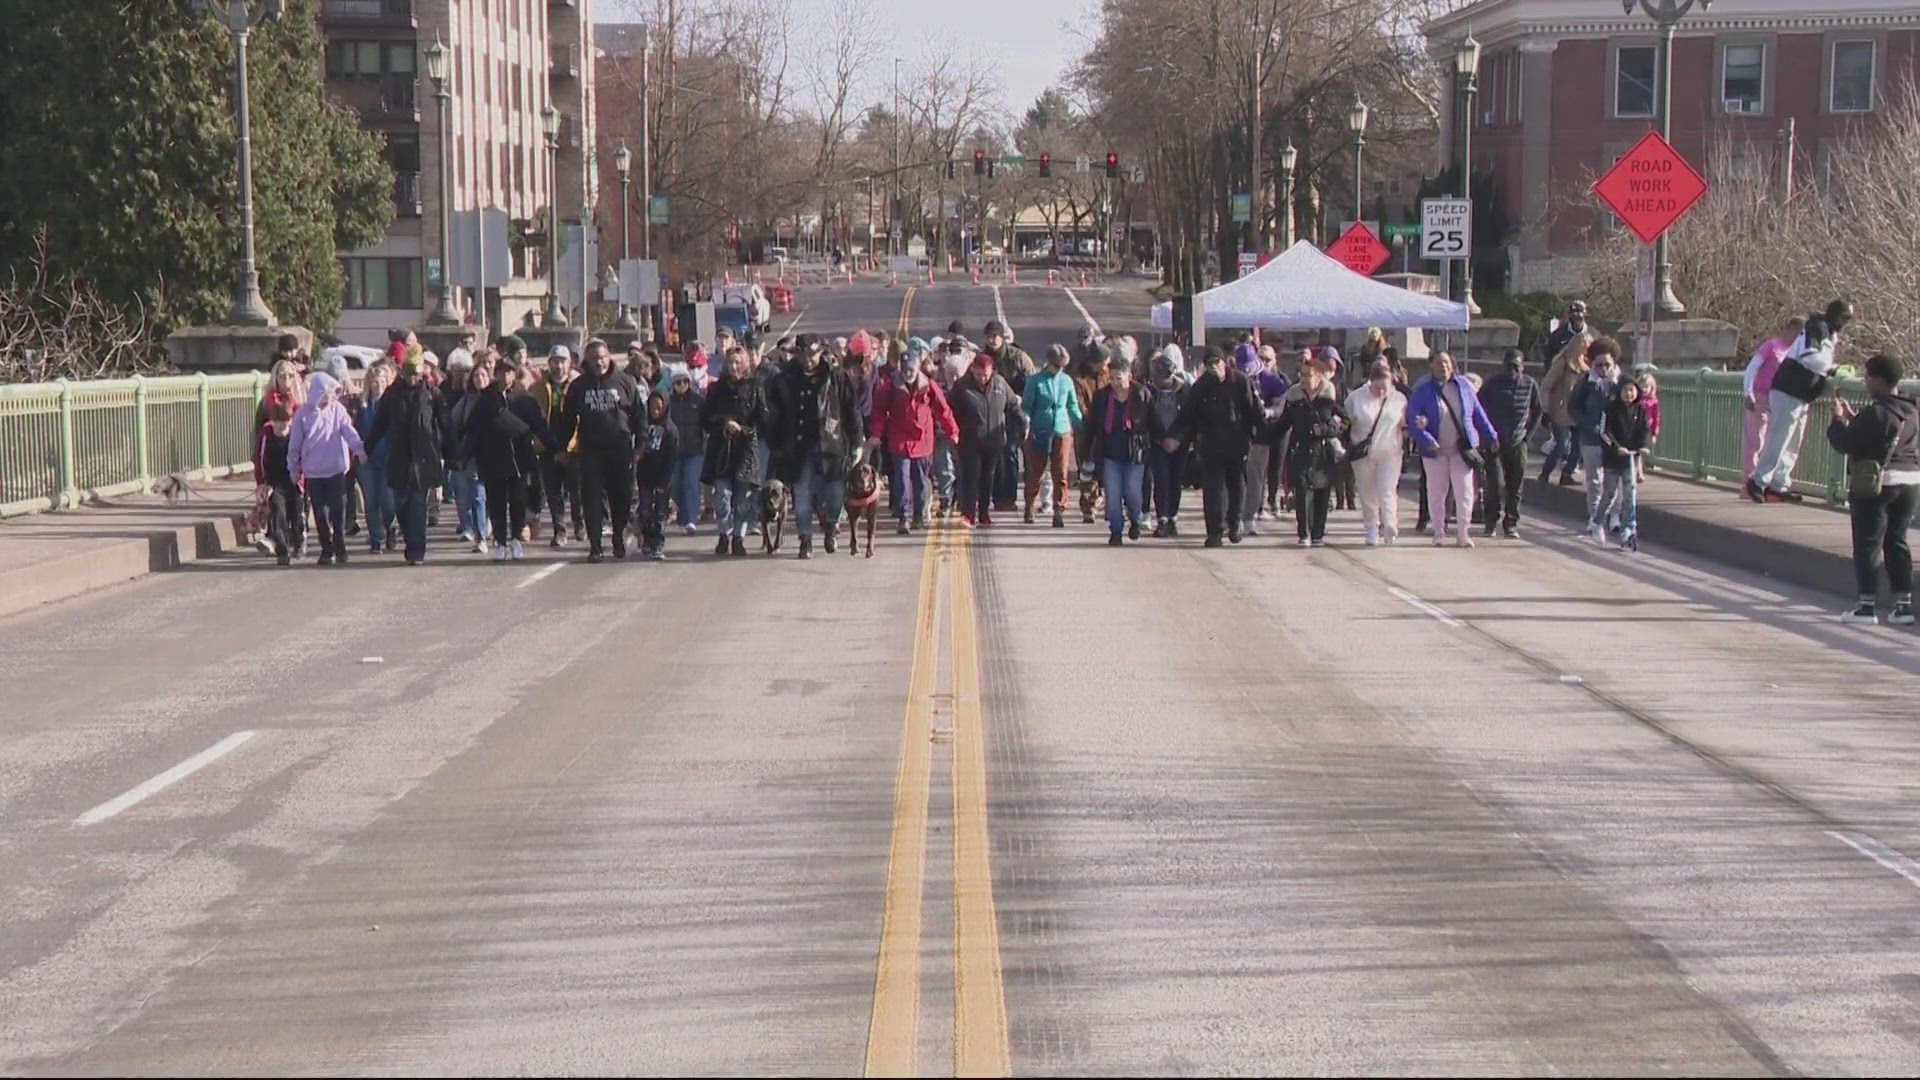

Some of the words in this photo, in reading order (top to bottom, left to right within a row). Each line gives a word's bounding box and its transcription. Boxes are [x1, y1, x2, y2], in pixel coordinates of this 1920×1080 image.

[1631, 160, 1672, 172] ROAD
[1630, 179, 1671, 192] WORK
[1426, 205, 1467, 214] SPEED
[1624, 199, 1677, 212] AHEAD
[1430, 217, 1461, 226] LIMIT
[1345, 236, 1372, 244] CENTER
[1427, 231, 1463, 252] 25
[1348, 245, 1368, 253] LANE
